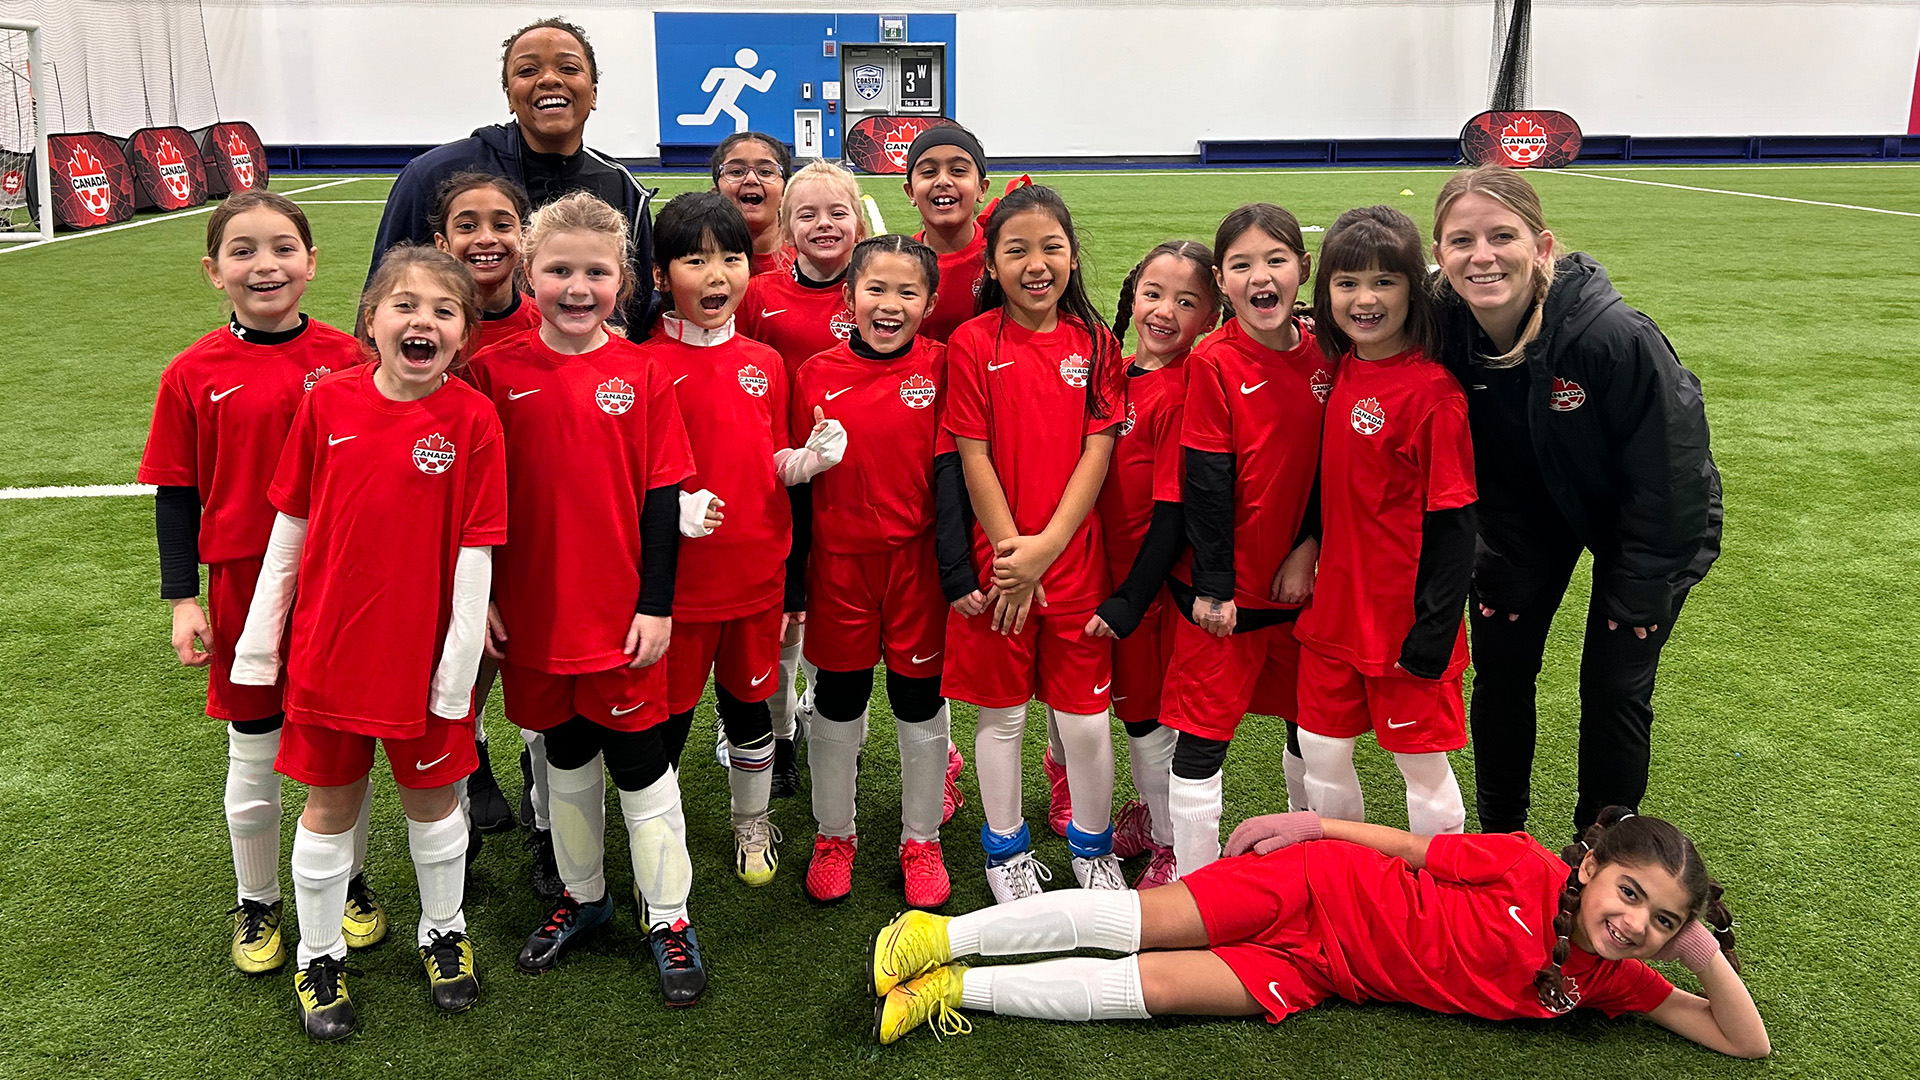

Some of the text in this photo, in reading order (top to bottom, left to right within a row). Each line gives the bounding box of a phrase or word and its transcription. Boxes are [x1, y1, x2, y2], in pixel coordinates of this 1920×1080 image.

[917, 64, 927, 79] W
[906, 71, 915, 92] 3
[1501, 137, 1546, 145] CANADA
[231, 156, 251, 165] CANADA
[160, 165, 187, 176] CANADA
[72, 175, 108, 189] CANADA
[830, 322, 857, 330] CANAD
[739, 377, 766, 385] CANADA
[596, 392, 634, 401] CANADA
[1551, 390, 1584, 399] NADA
[1352, 407, 1382, 426] CANADA
[413, 449, 454, 460] CANADA
